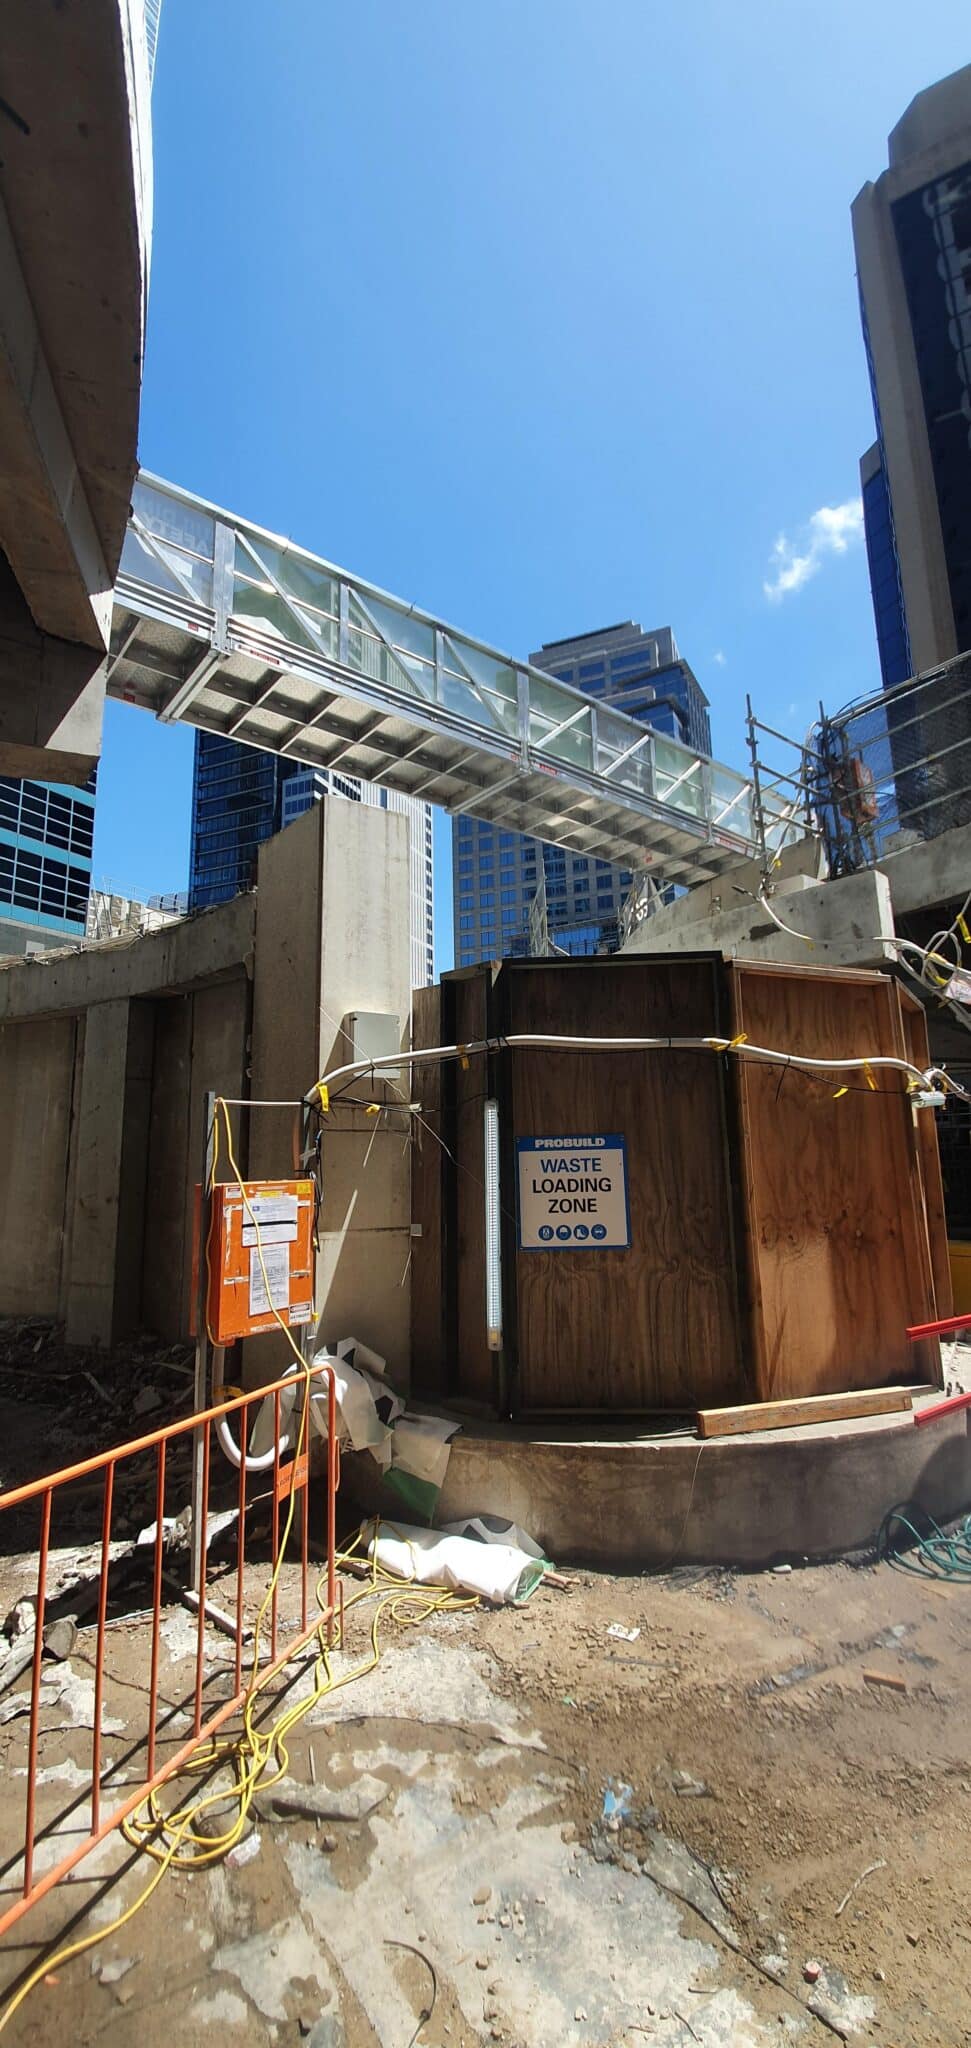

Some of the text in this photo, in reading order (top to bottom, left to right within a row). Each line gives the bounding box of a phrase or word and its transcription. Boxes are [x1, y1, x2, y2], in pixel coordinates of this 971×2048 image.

[535, 1138, 605, 1148] PROBUILD
[541, 1158, 602, 1173] WASTE
[532, 1177, 611, 1193] LOADING
[548, 1198, 597, 1214] ZONE
